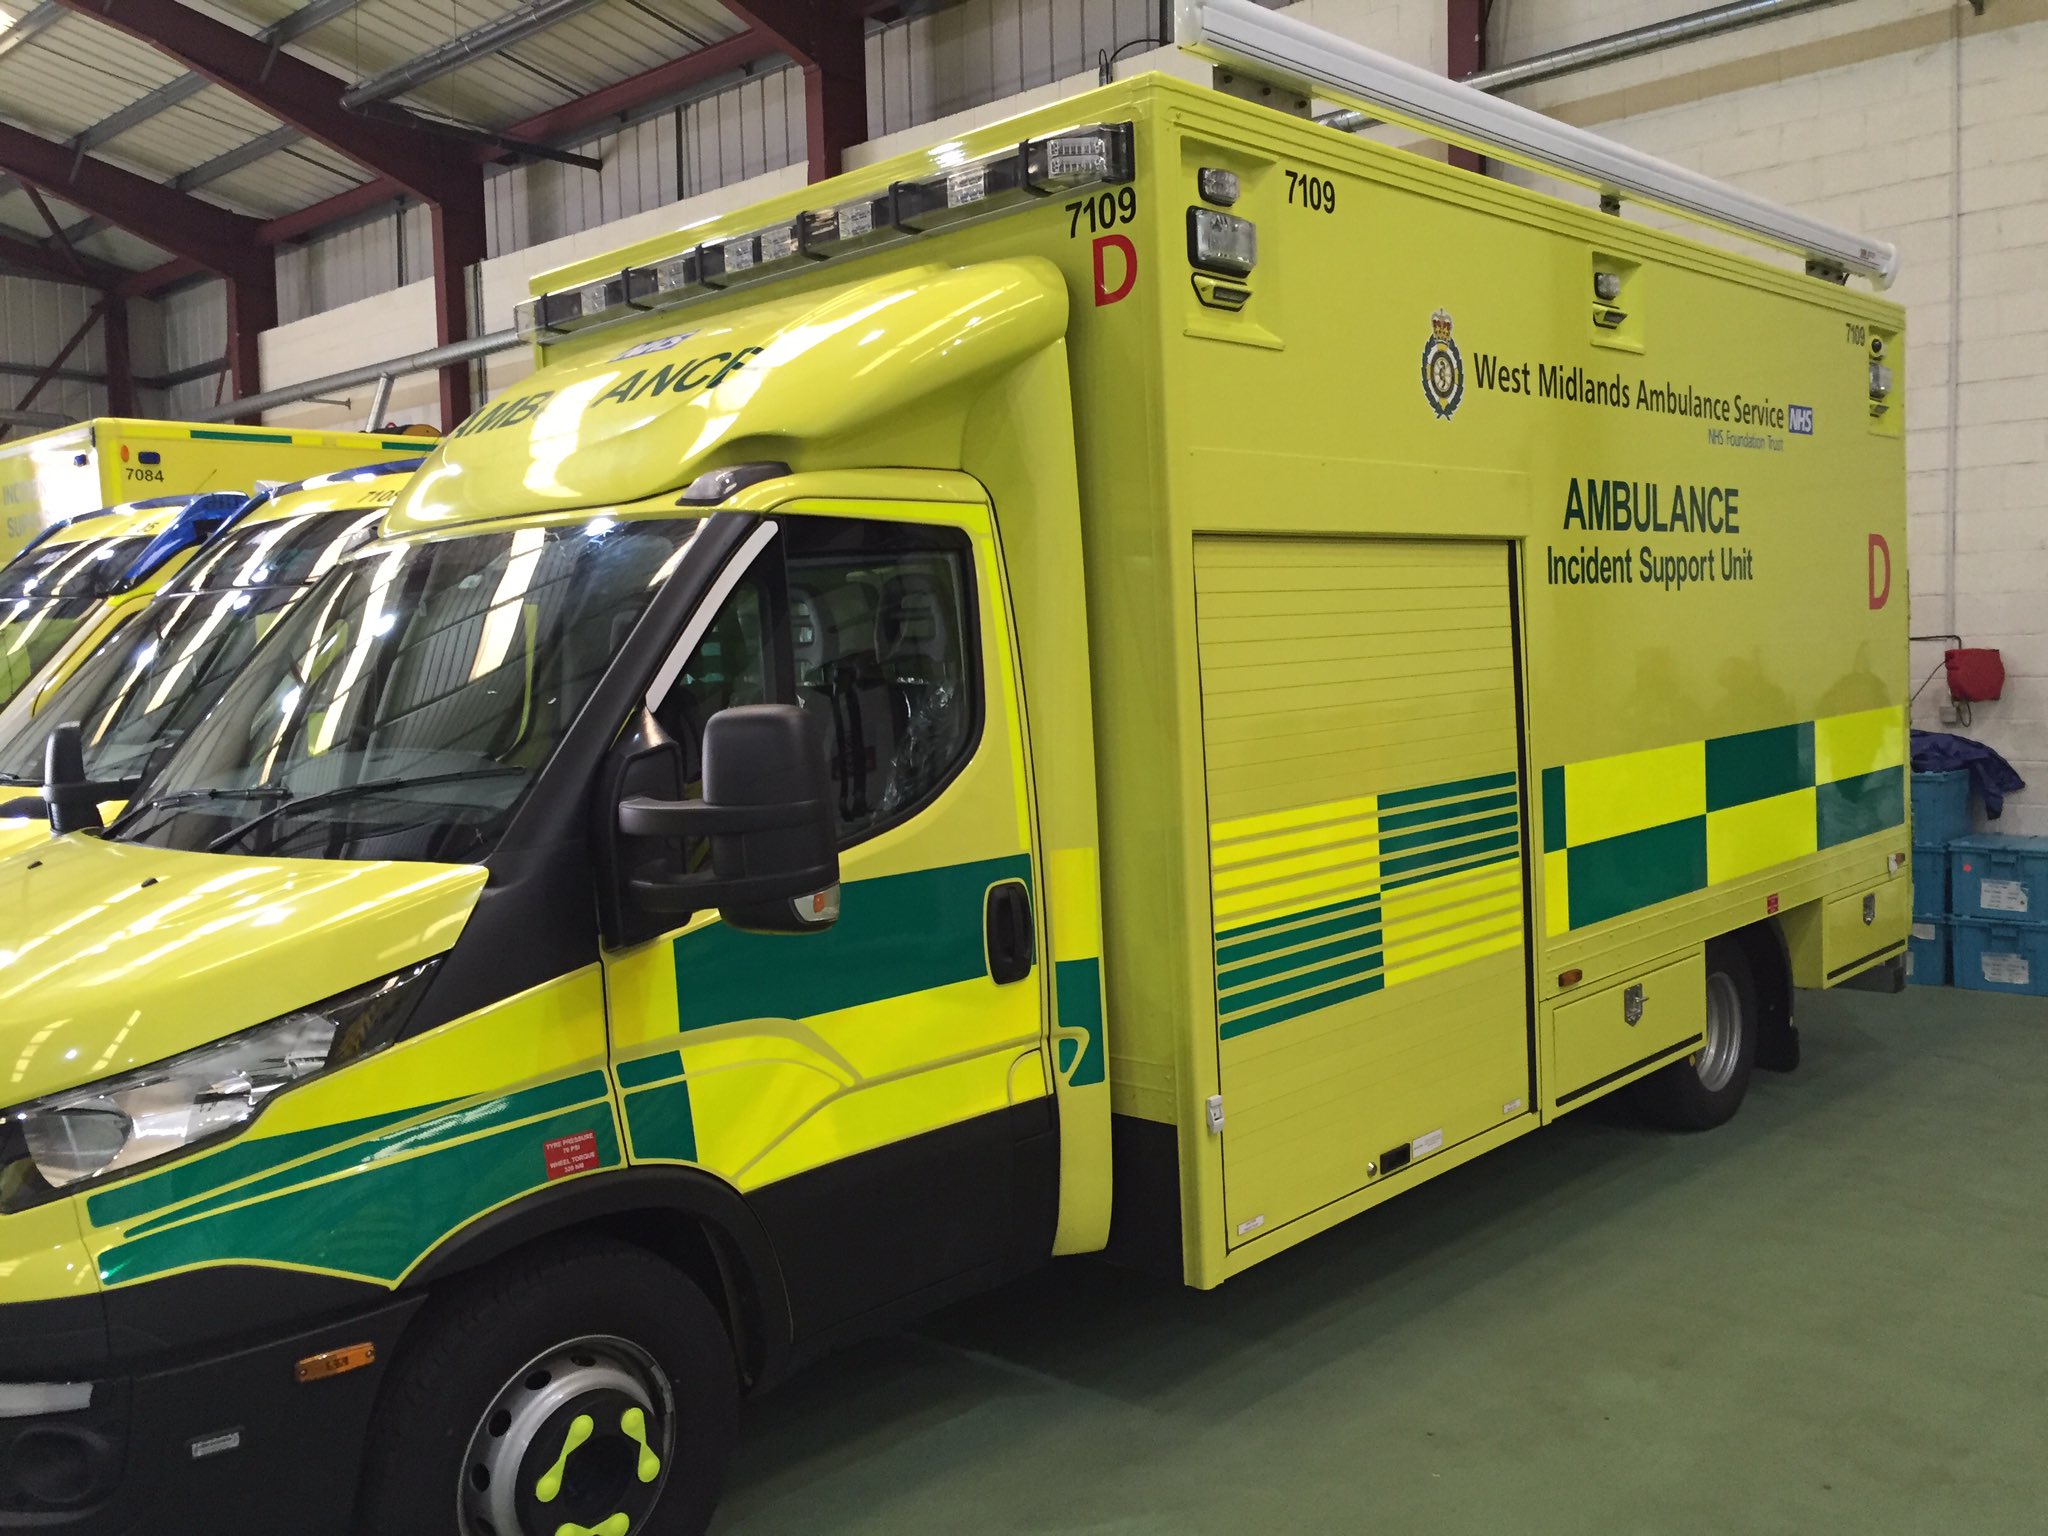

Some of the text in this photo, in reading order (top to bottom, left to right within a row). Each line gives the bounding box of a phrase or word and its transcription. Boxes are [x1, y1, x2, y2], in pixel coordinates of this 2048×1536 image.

[1065, 187, 1137, 238] 7109
[1285, 170, 1336, 214] 7109
[1093, 234, 1137, 307] D
[1845, 322, 1866, 347] 7109
[454, 346, 765, 439] AMBANCE
[1473, 352, 1813, 433] West Midlands Ambulance Service NHS
[1707, 428, 1785, 452] NHS Foundation Trust
[125, 467, 165, 484] 7084
[1563, 477, 1741, 534] AMBULANCE
[1547, 545, 1754, 591] Incident Support Unit
[1868, 532, 1891, 610] D
[546, 1133, 593, 1150] TYRE PRESSURE
[549, 1152, 595, 1169] WHEEL TORQUE
